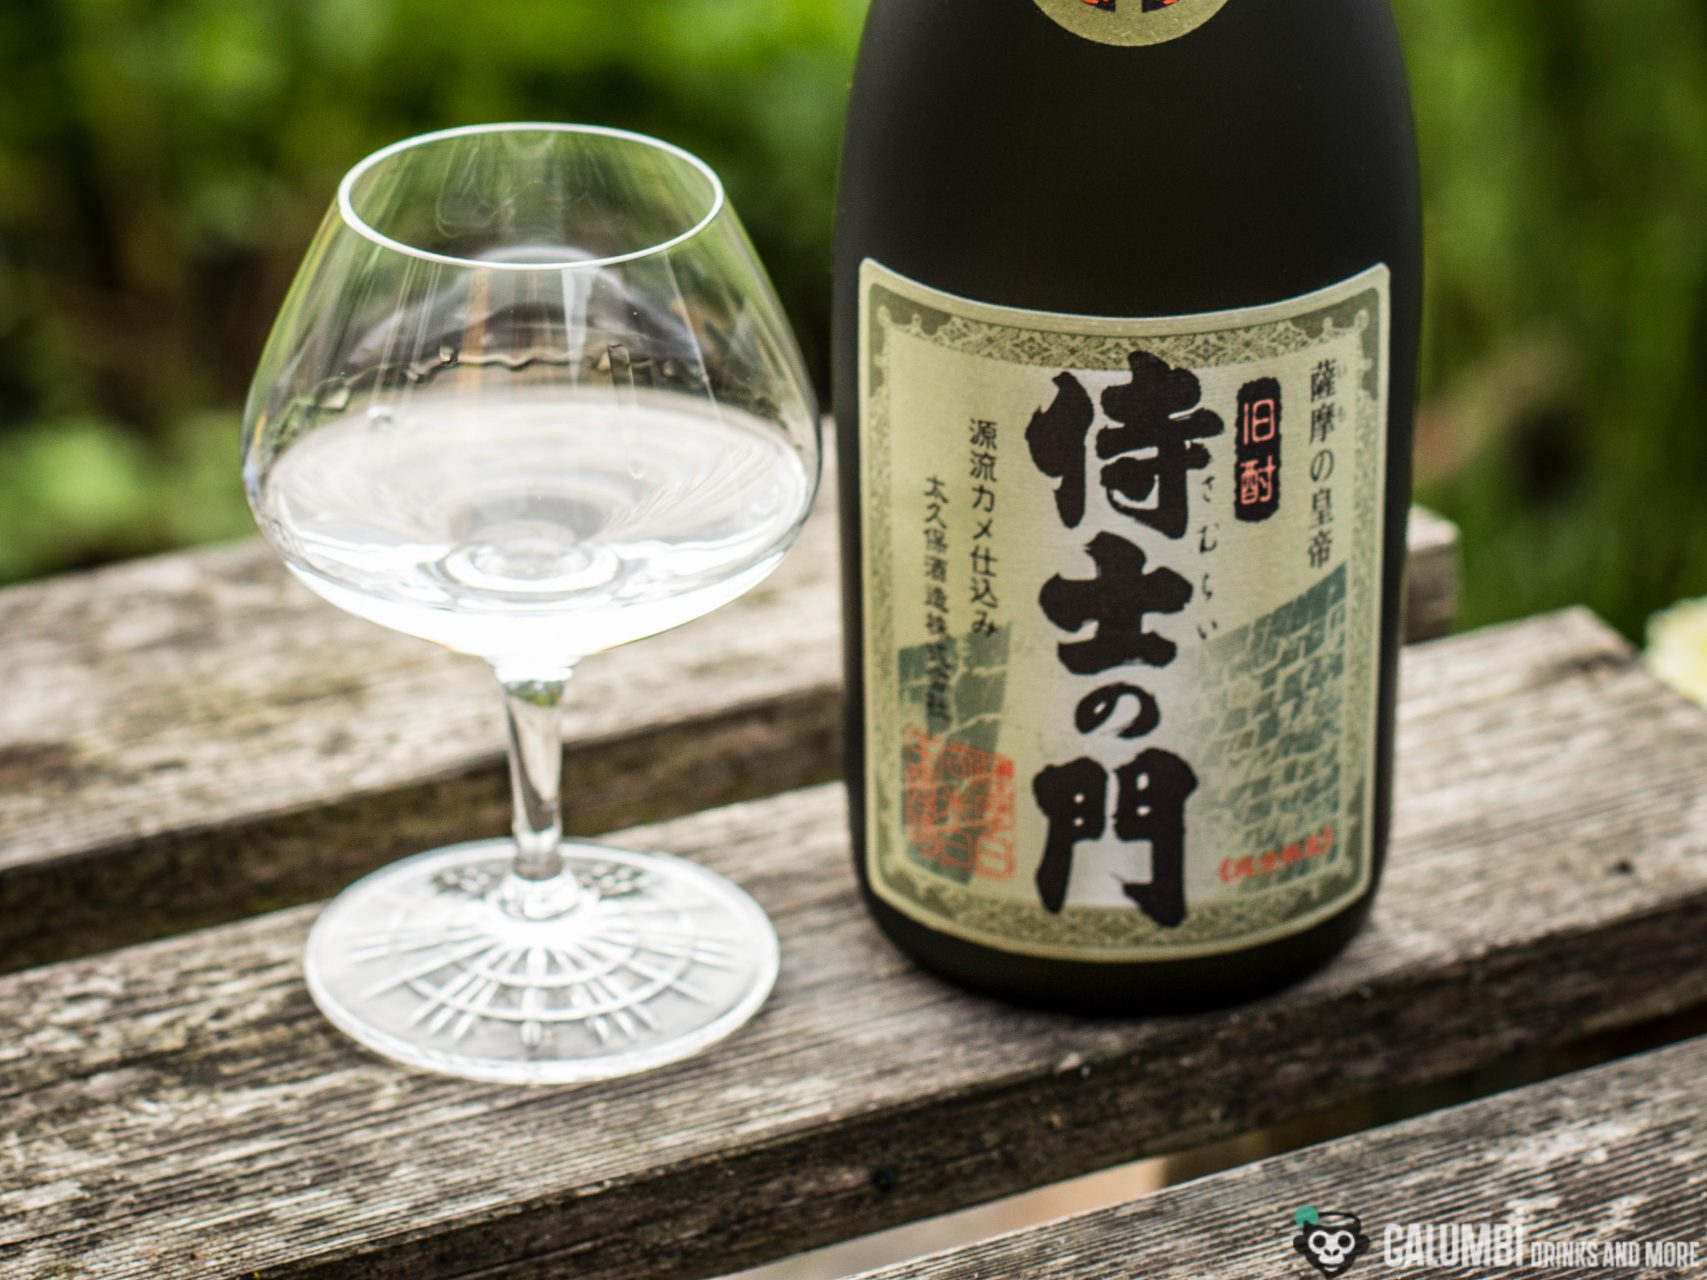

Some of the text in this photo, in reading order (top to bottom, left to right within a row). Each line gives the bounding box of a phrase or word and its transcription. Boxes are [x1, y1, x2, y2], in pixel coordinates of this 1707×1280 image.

[969, 417, 999, 639] 源流カメ仕込み
[1240, 398, 1277, 506] 旧酎
[1308, 358, 1337, 569] 薩摩の皇帝
